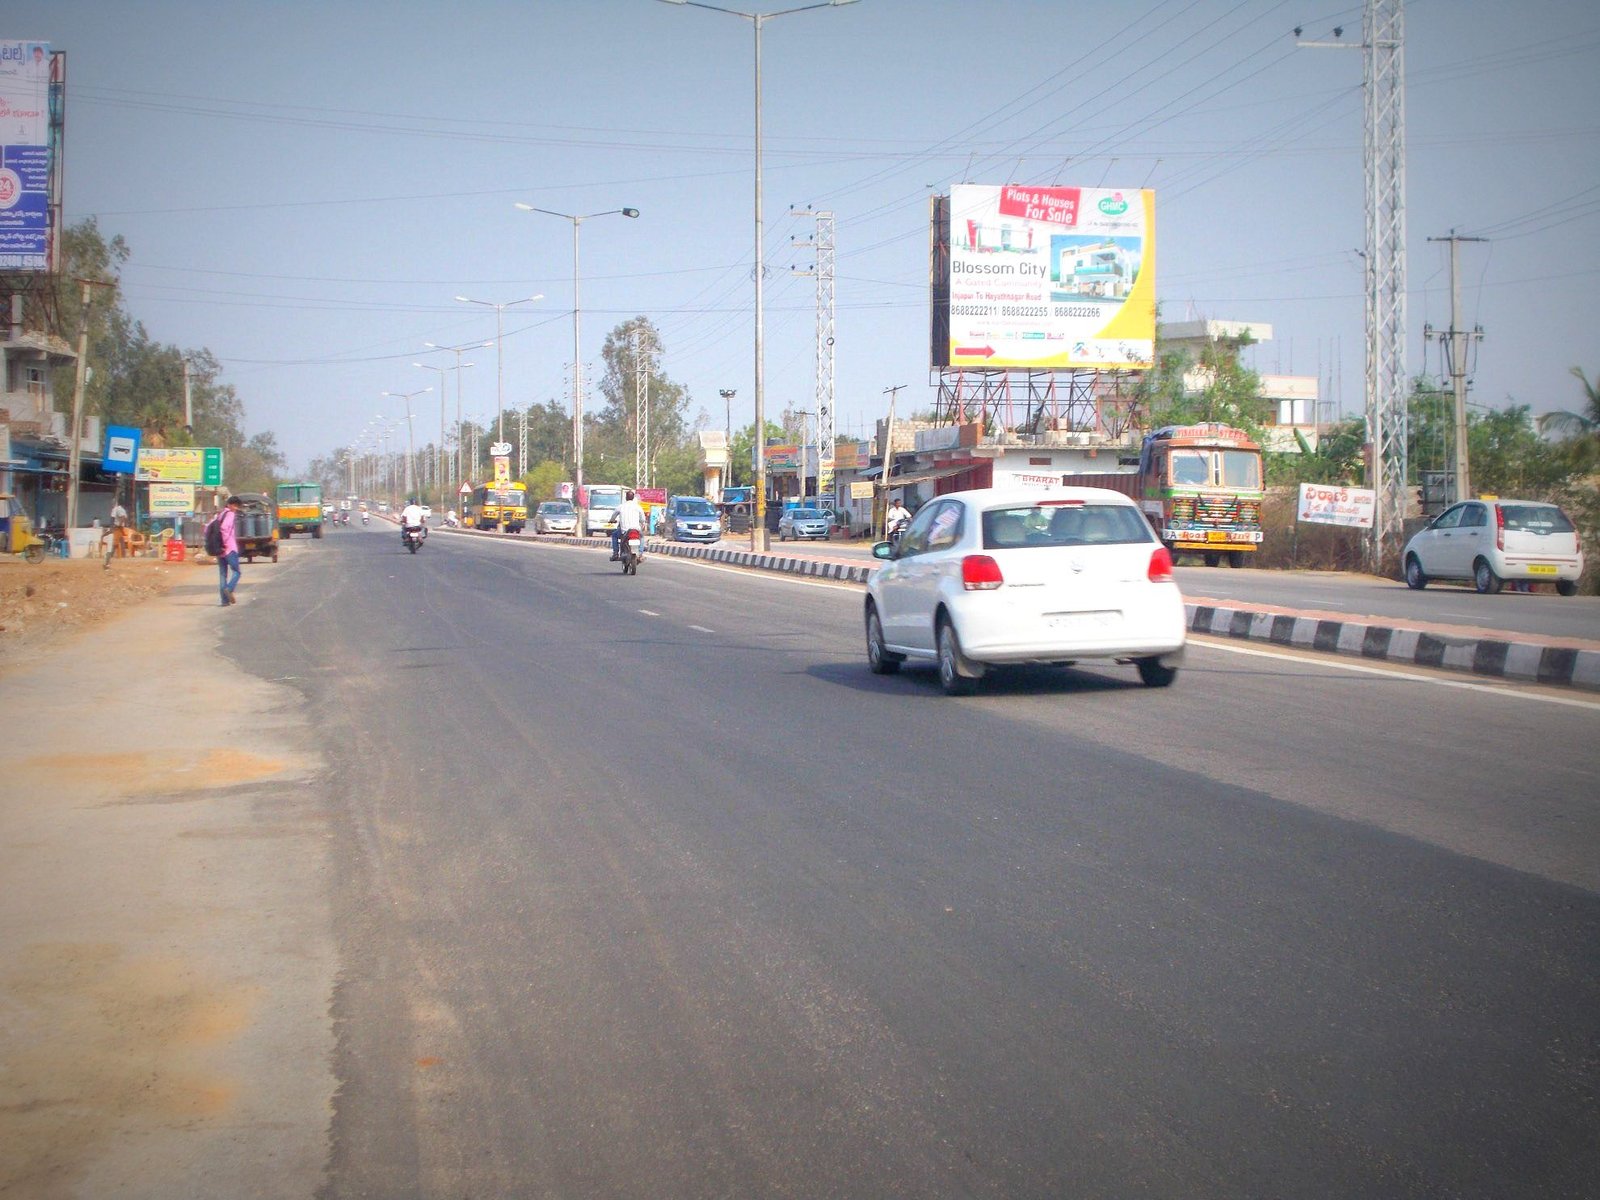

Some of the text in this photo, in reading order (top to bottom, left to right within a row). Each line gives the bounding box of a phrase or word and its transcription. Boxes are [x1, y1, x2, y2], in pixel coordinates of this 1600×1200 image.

[1007, 188, 1074, 209] Plots & Houses
[1025, 203, 1073, 224] For Sale
[1100, 201, 1124, 212] GHMC
[952, 260, 1047, 279] Blossom City
[976, 291, 984, 300] To
[1026, 292, 1042, 301] Road
[951, 304, 1101, 318] 8688222211 8688222255 8688222266
[1022, 475, 1059, 484] BHARAT
